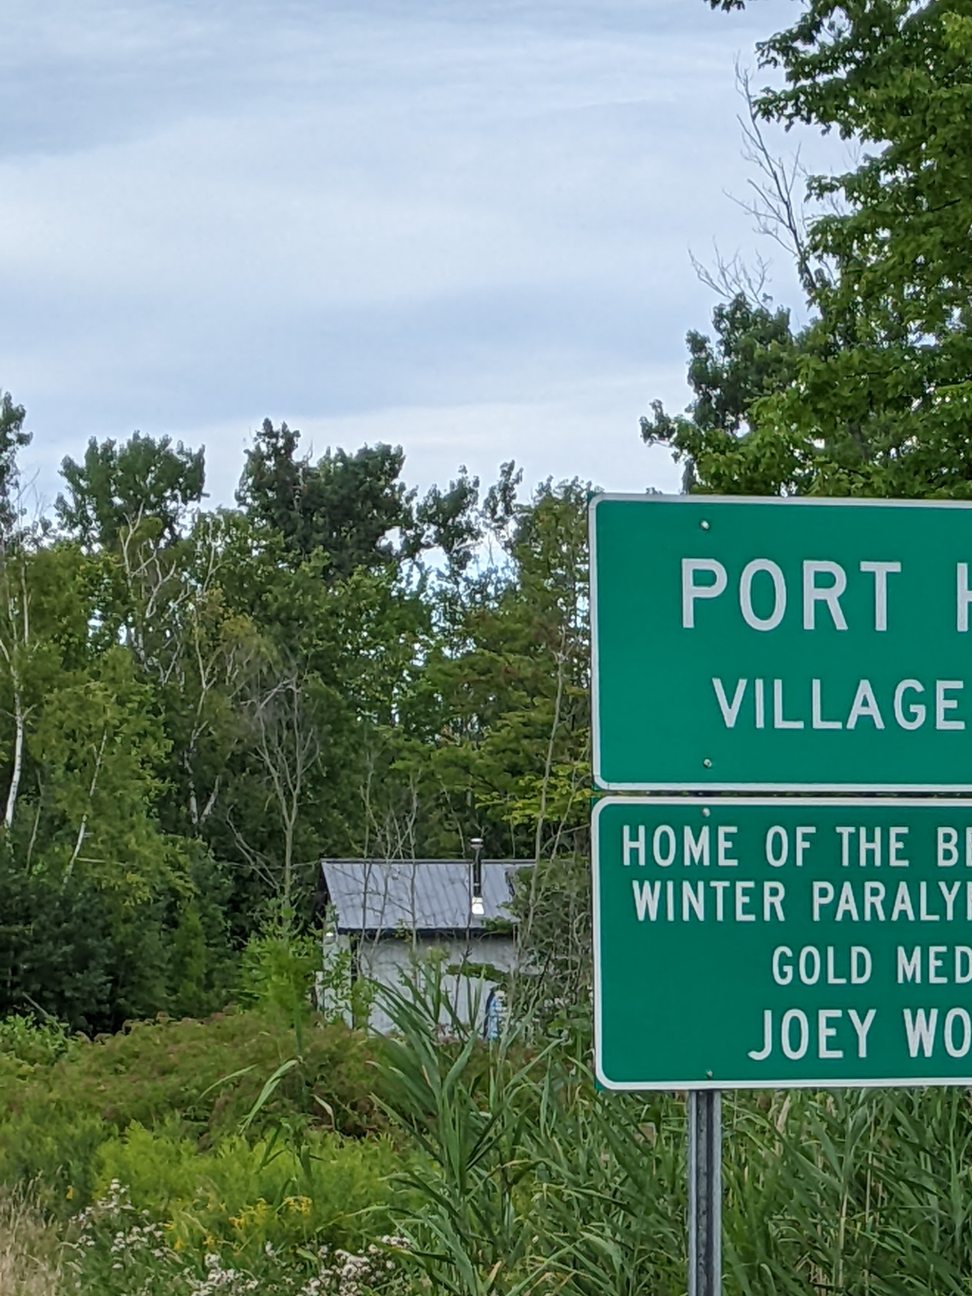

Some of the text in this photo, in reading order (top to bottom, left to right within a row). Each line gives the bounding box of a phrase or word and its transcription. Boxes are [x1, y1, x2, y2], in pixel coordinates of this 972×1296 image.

[681, 558, 901, 631] PORT
[712, 678, 965, 730] VILLAGE
[622, 825, 738, 867] HOME
[765, 825, 816, 867] OF
[835, 826, 909, 867] THE
[632, 880, 785, 922] WINTER
[772, 946, 872, 986] GOLD
[748, 1008, 876, 1061] JOEY
